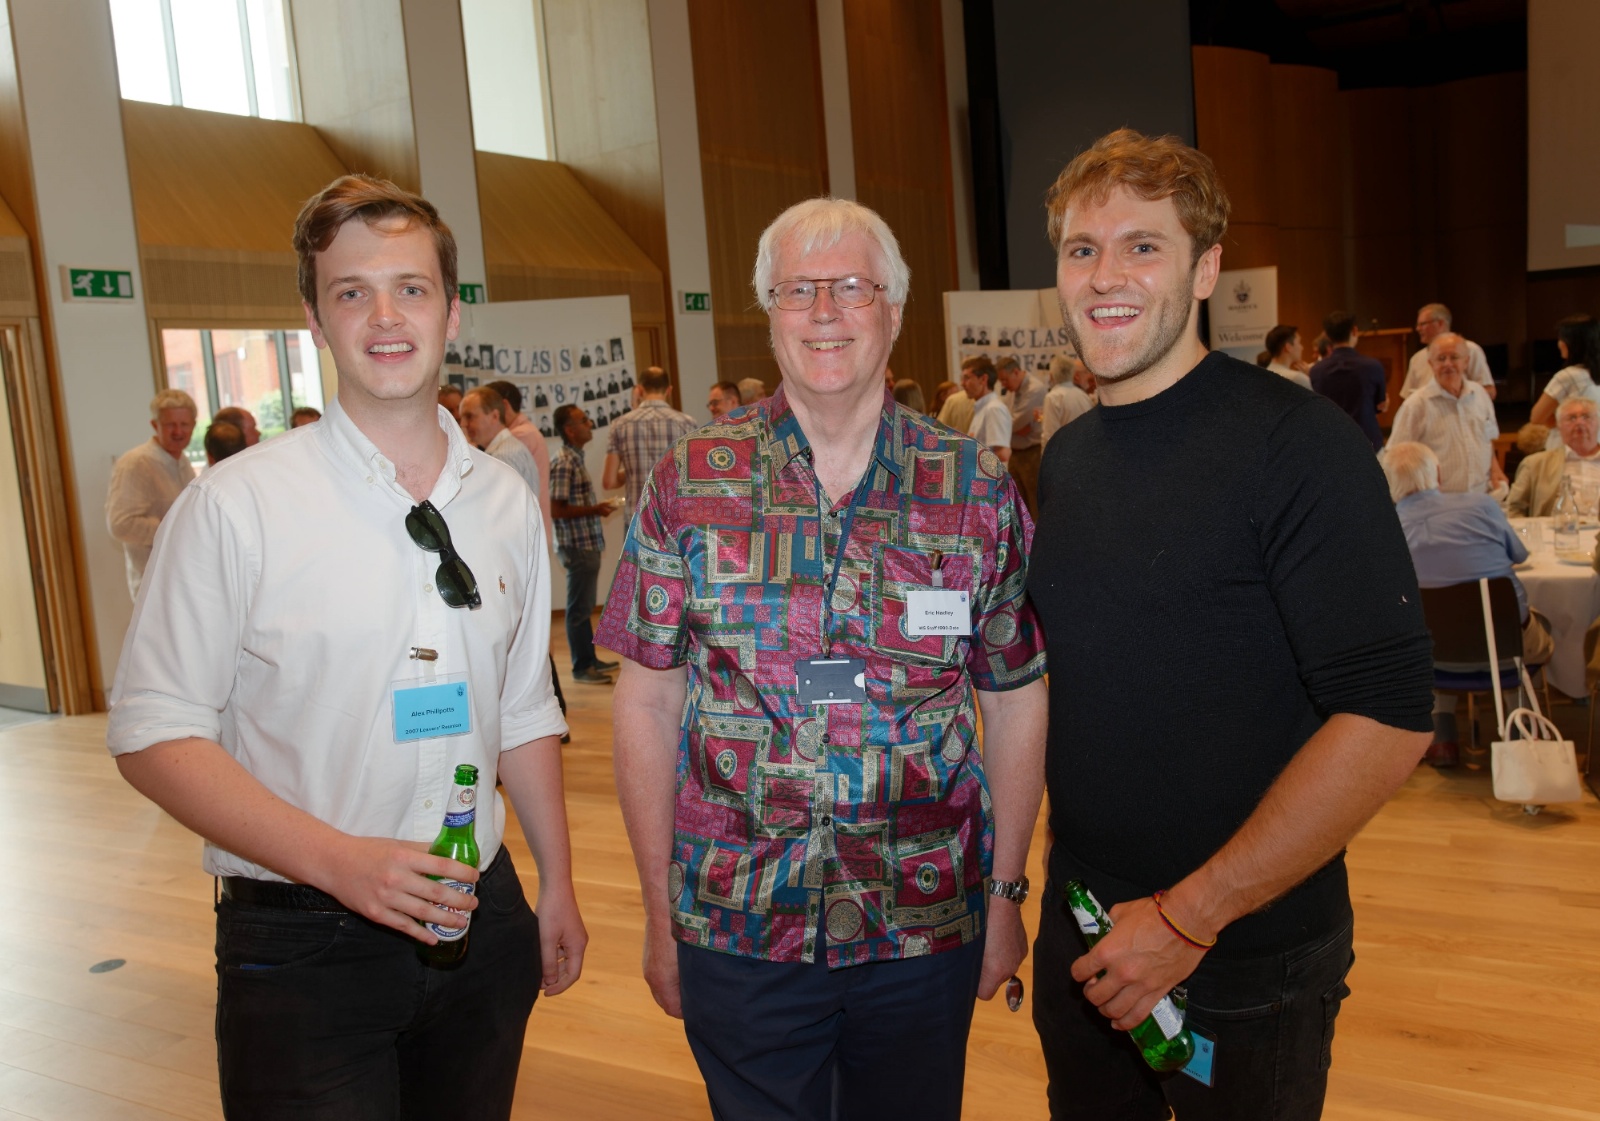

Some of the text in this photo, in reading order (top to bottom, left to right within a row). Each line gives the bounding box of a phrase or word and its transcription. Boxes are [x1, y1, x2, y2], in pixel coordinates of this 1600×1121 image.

[1012, 328, 1070, 348] CLAS
[495, 348, 572, 375] CLASS
[411, 710, 425, 718] Alex
